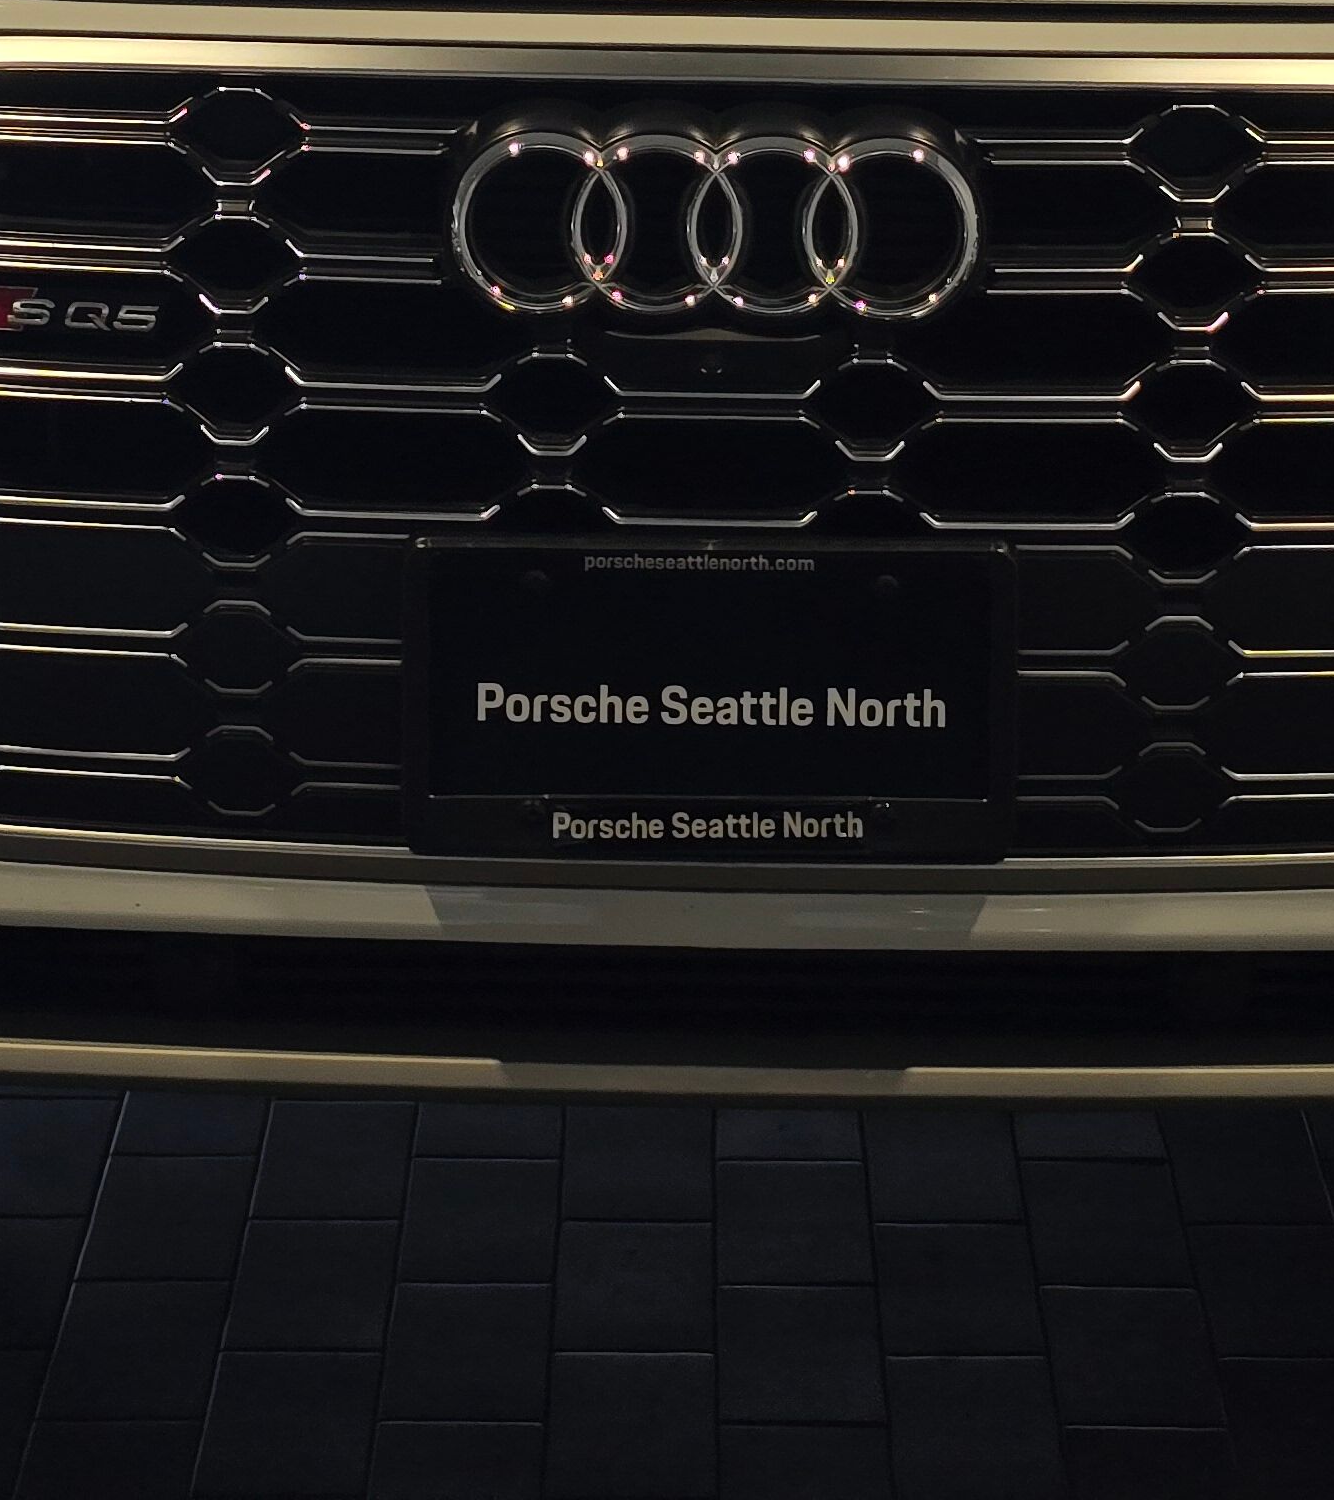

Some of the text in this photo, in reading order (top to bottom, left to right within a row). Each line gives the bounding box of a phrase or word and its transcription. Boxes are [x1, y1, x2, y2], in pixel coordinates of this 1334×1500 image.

[584, 553, 815, 572] porscheseattlenorth.com
[476, 682, 946, 728] Porsche Seattle North
[552, 811, 864, 840] Porsche Seattle North
